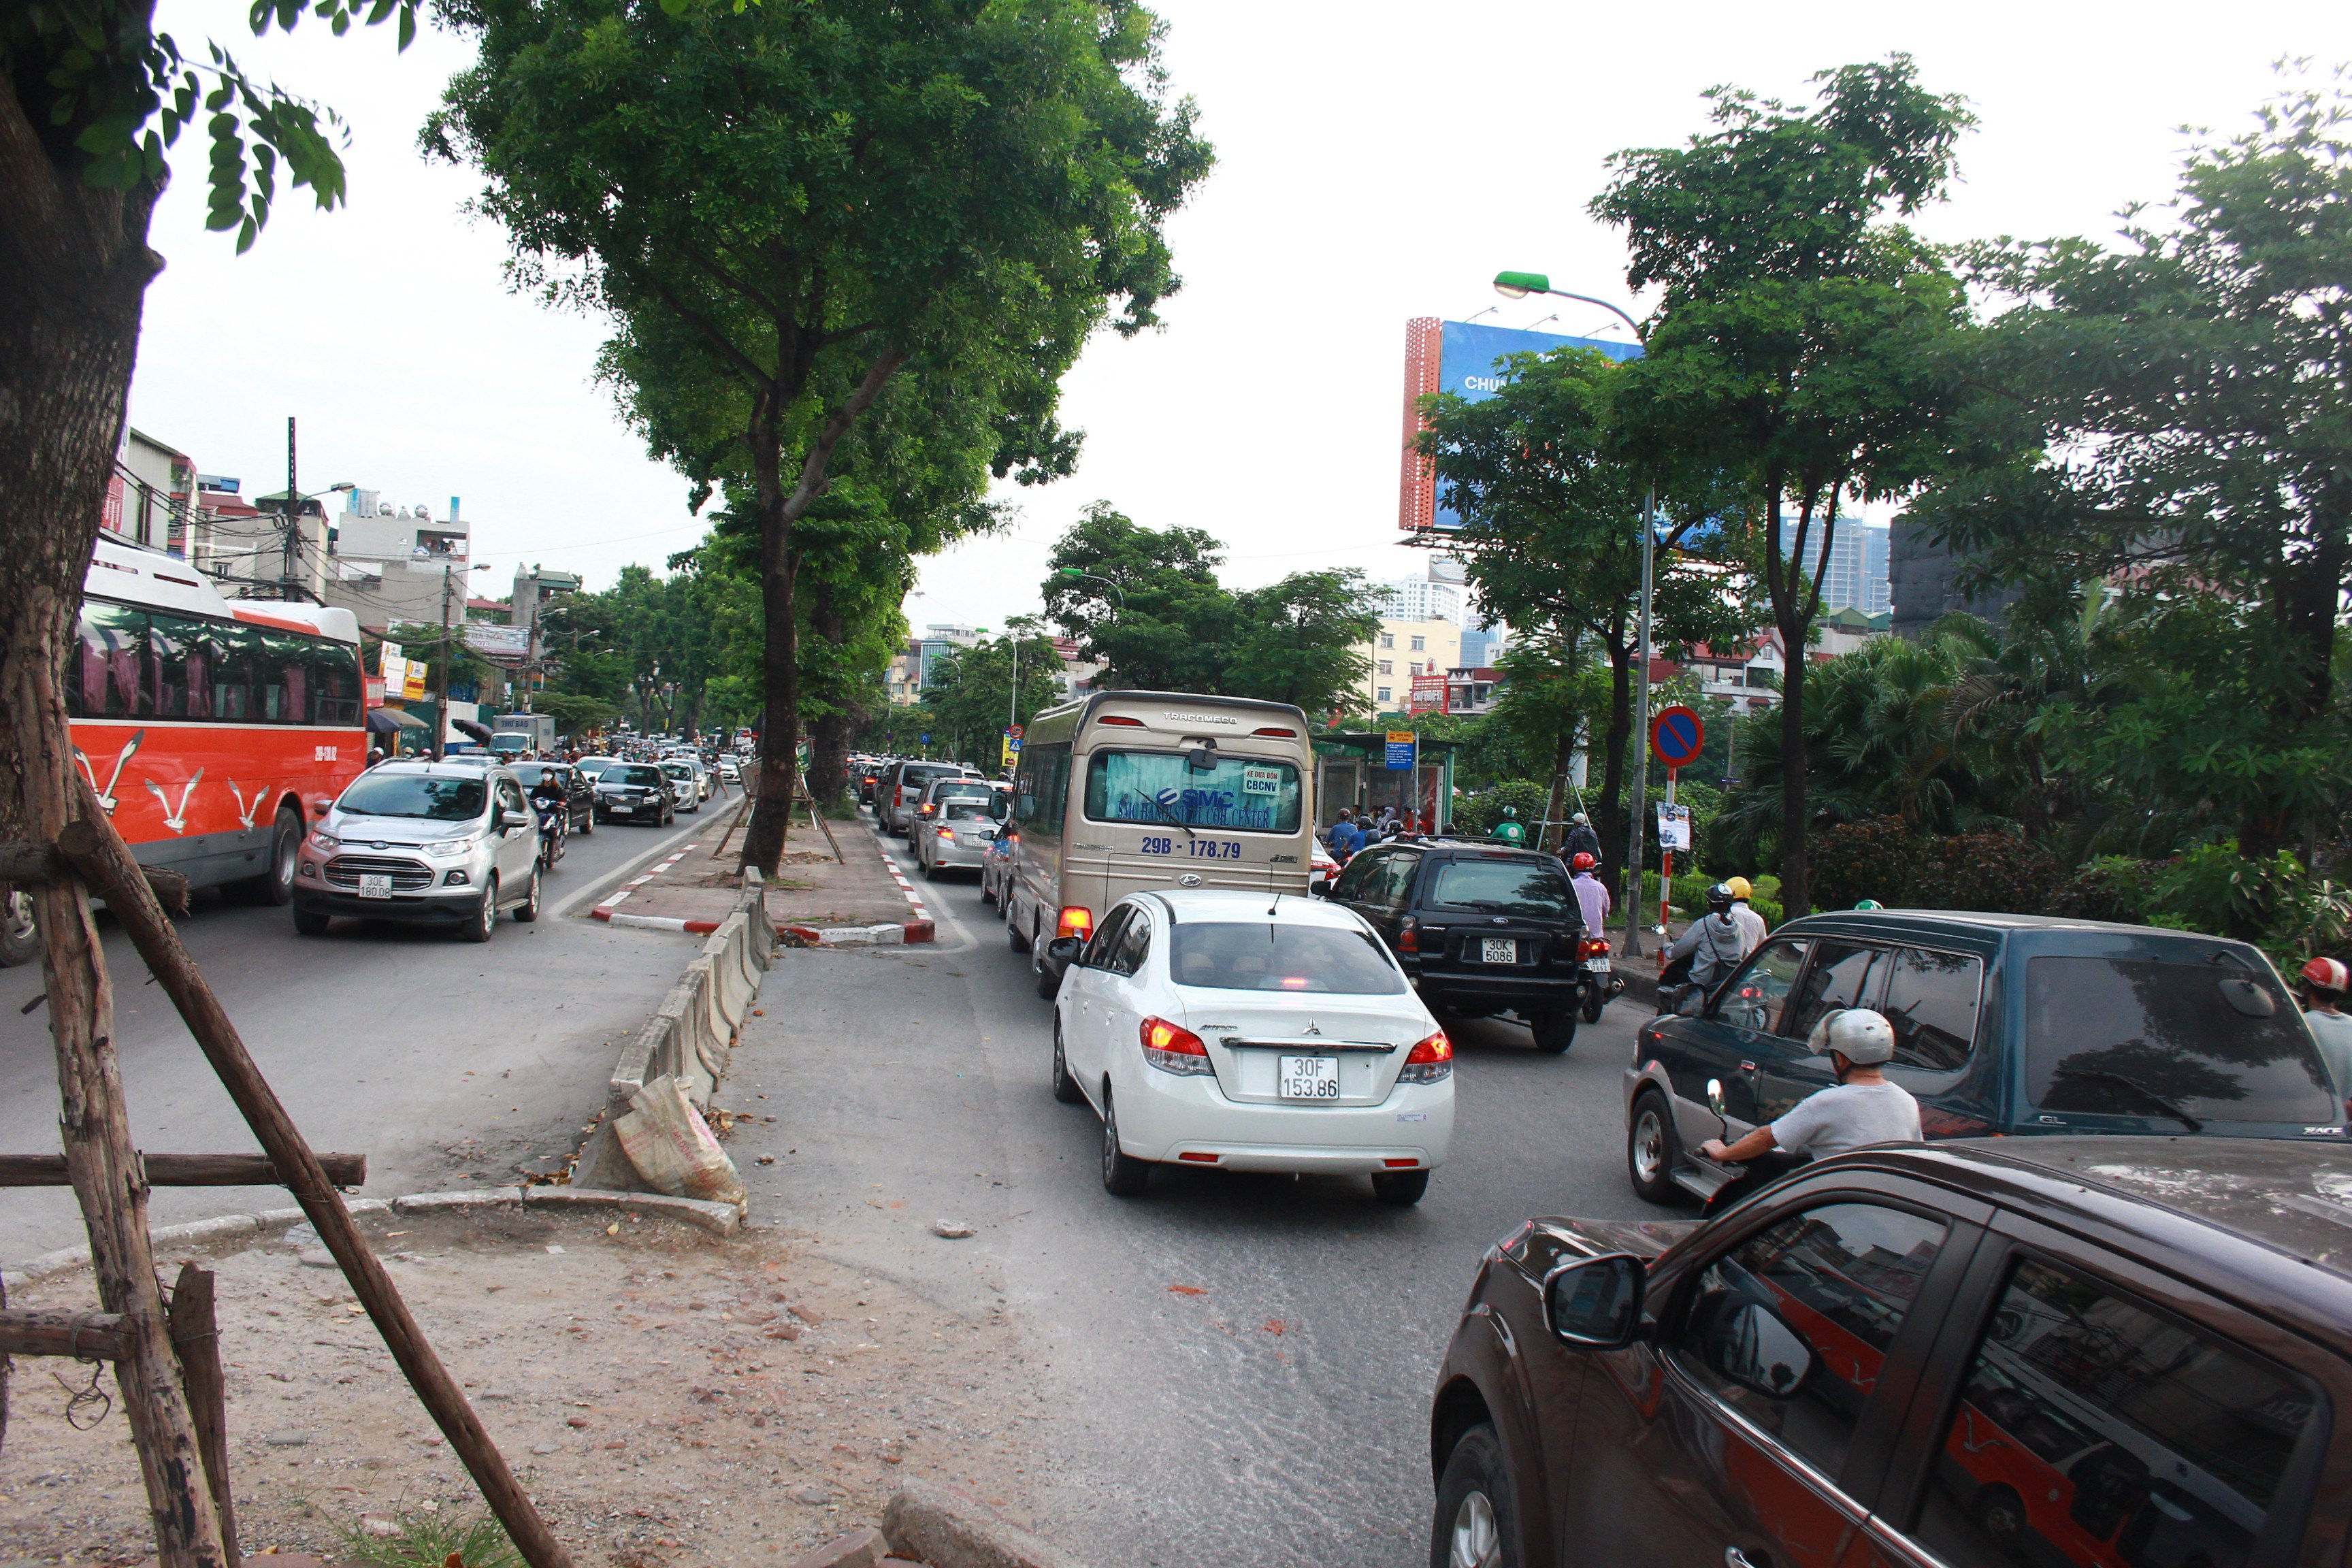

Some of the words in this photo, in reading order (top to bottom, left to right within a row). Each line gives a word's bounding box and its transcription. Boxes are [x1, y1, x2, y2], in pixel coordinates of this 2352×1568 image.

[1163, 712, 1237, 724] TRACOMECO
[1246, 780, 1277, 792] CBCNV
[1182, 788, 1235, 808] SMC
[1232, 808, 1269, 828] CENTER
[1141, 837, 1171, 854] 29B
[1189, 840, 1241, 859] 178.79
[368, 876, 385, 887] 30E
[361, 886, 391, 898] 180.08
[1489, 939, 1509, 951] 30K
[1486, 951, 1513, 962] 5086
[1294, 1058, 1325, 1077] 30F
[1284, 1078, 1337, 1098] 153.86
